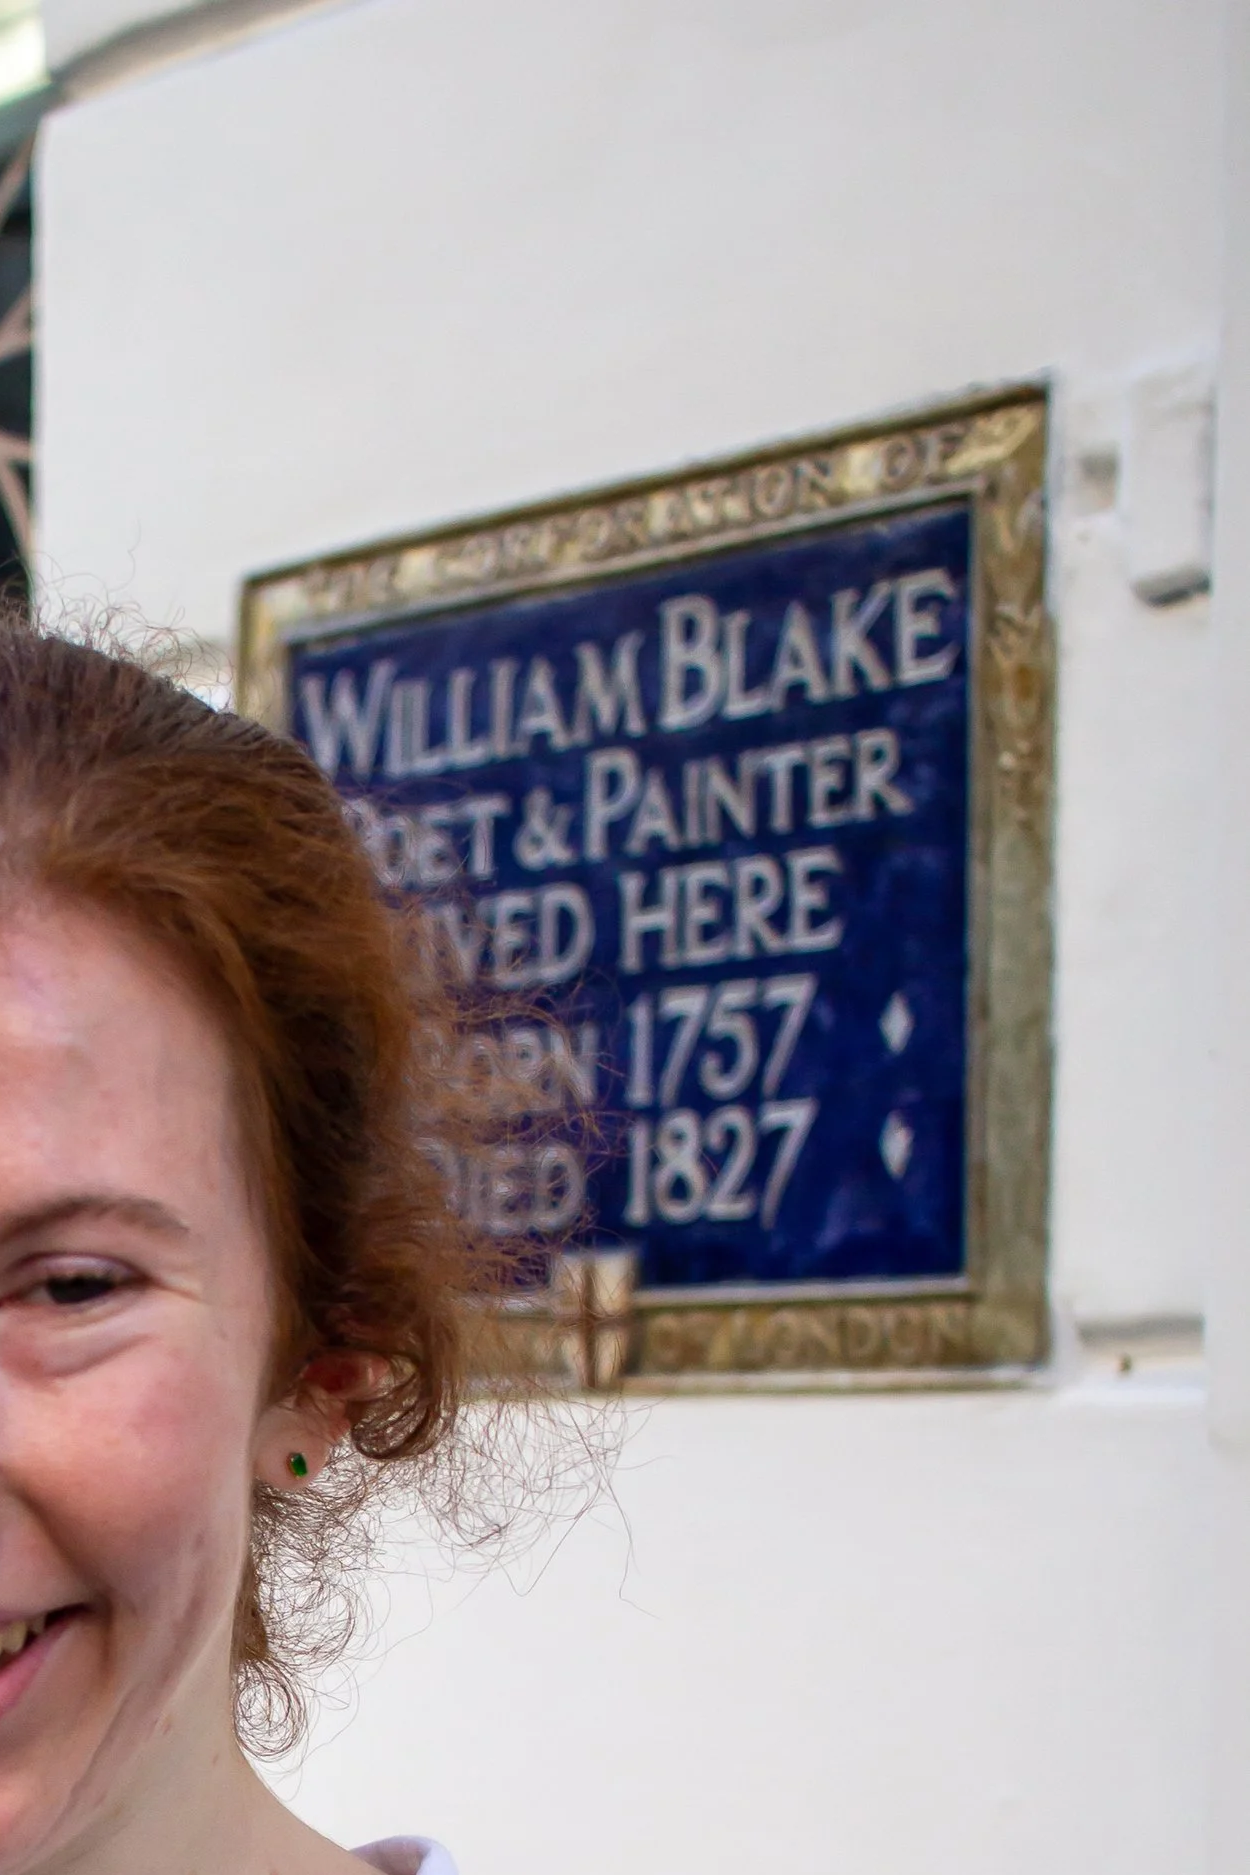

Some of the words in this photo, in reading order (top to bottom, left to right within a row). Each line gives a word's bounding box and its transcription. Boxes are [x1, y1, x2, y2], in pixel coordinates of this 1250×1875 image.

[300, 630, 646, 780] WILLIAM
[659, 568, 962, 732] BLAKE
[512, 787, 580, 872] &
[584, 727, 915, 863] PAINTER
[618, 844, 846, 975] HERE
[624, 971, 819, 1108] 1757
[622, 1096, 819, 1231] 1827
